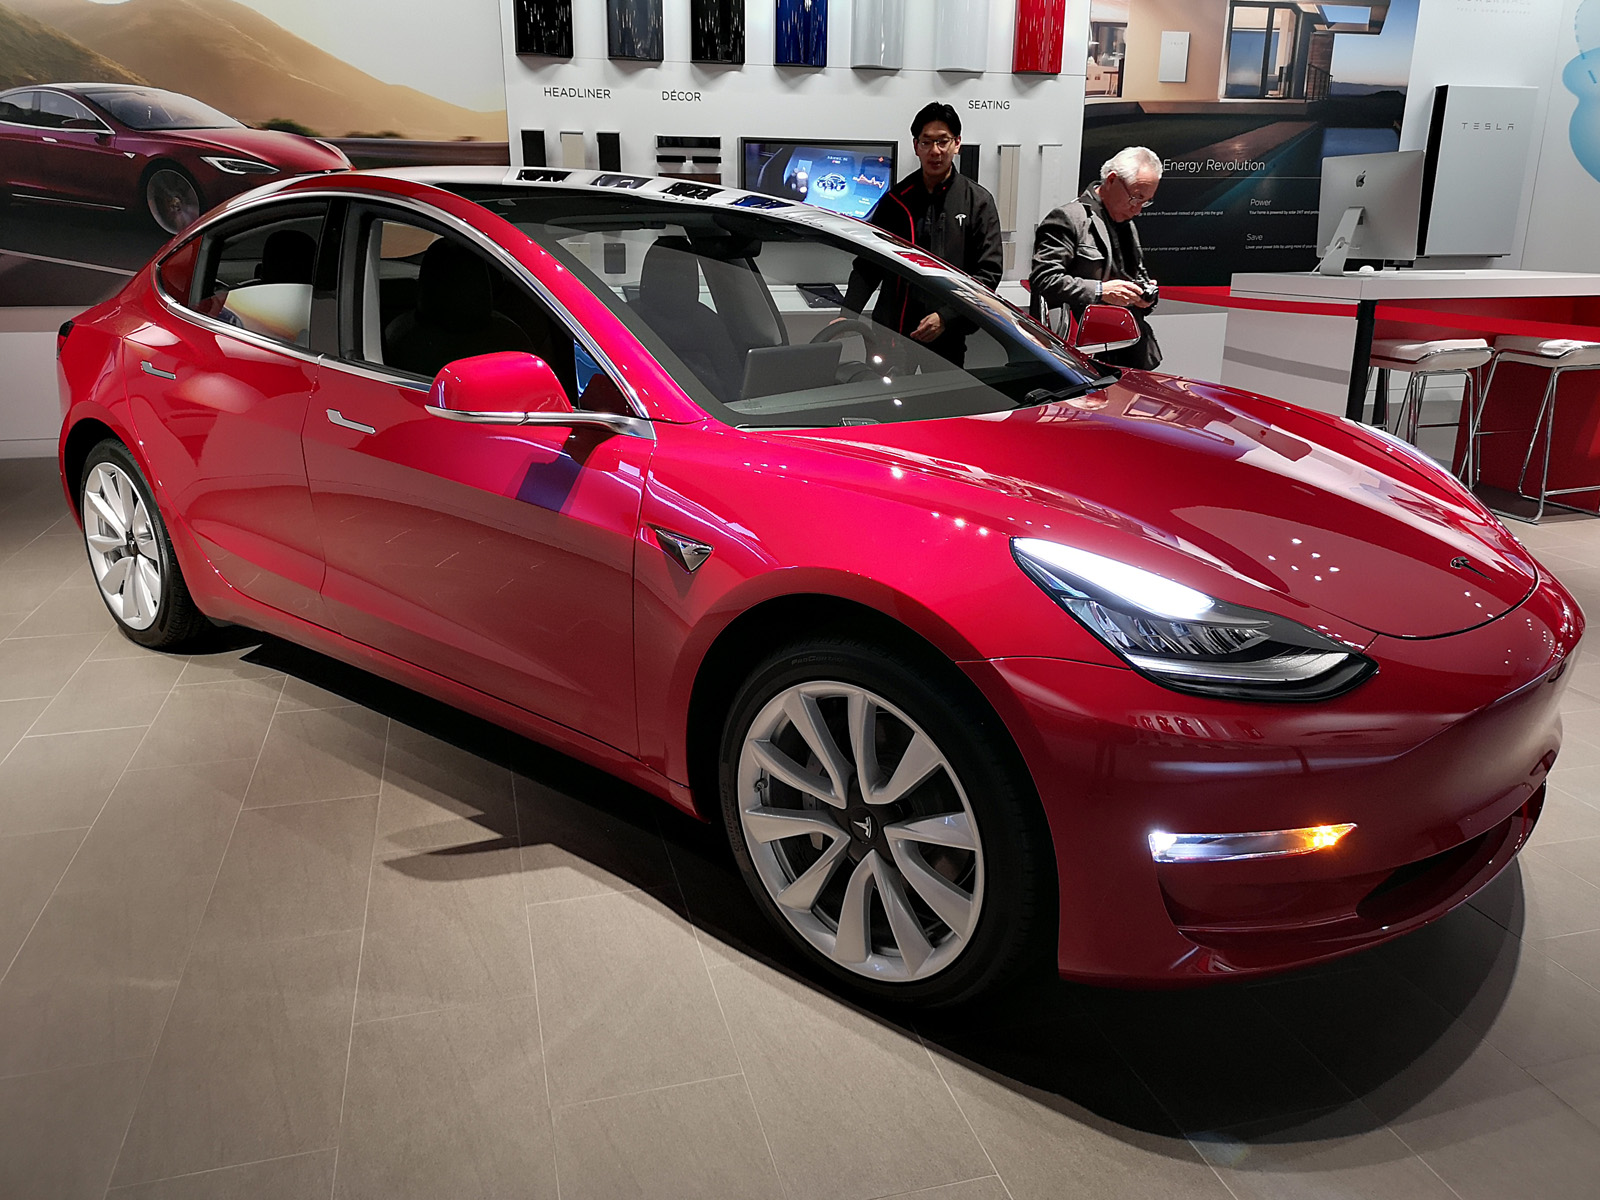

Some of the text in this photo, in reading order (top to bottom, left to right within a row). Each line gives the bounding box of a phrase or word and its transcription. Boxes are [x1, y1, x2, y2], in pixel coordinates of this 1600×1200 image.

[543, 86, 611, 99] HEADLINER
[661, 89, 702, 102] DÉCOR
[968, 99, 1010, 110] SEATING
[1461, 122, 1514, 131] TESLA
[1163, 158, 1266, 173] Energy Revolution
[1250, 198, 1272, 207] Power
[1246, 233, 1263, 241] Save
